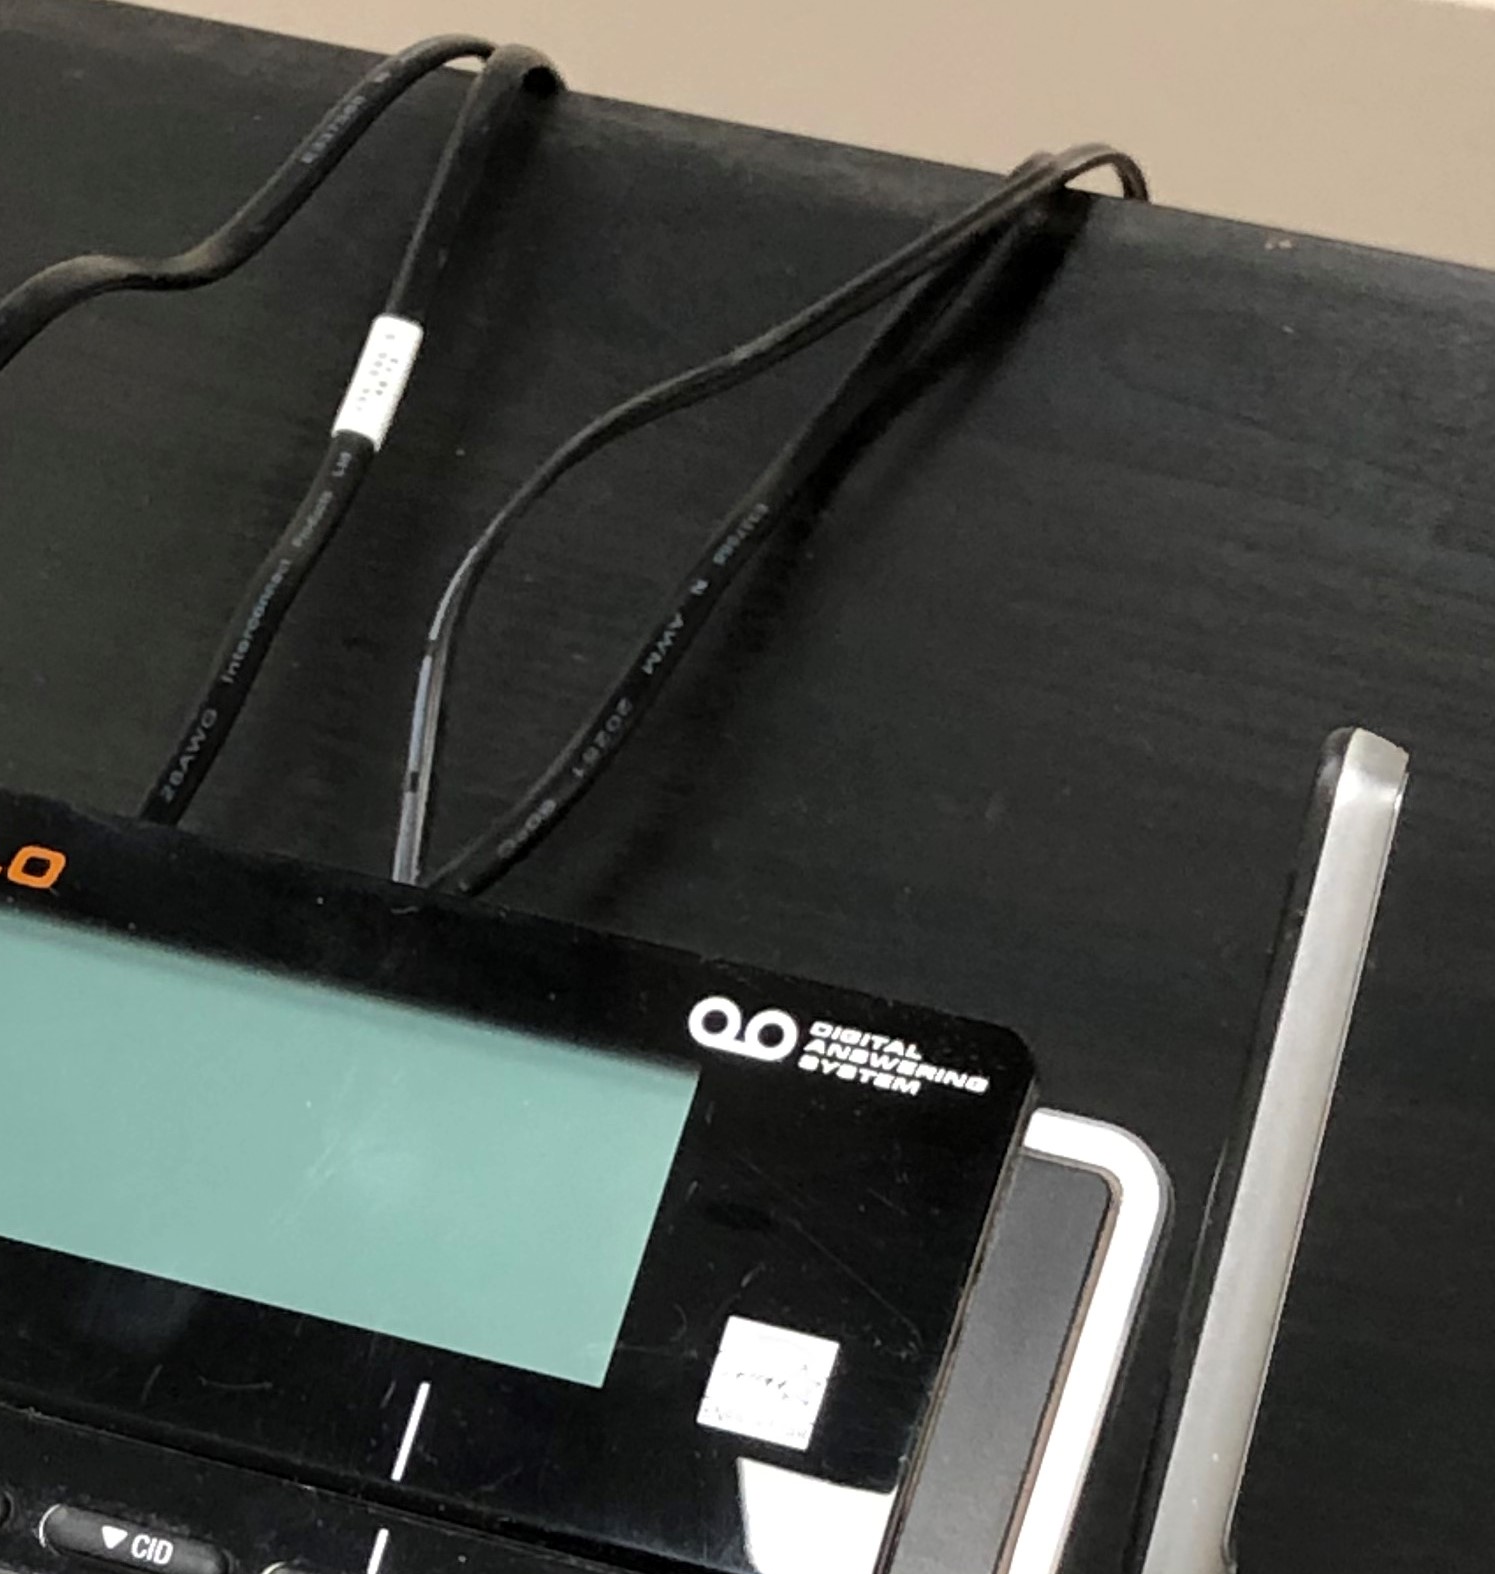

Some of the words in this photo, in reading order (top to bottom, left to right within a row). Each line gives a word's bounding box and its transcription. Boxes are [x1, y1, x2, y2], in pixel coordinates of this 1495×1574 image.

[642, 613, 684, 675] AWM
[808, 1021, 922, 1060] DIGITAL
[798, 1056, 922, 1096] SYSTEM
[803, 1039, 990, 1094] ANSWERING
[130, 1534, 174, 1565] CID
